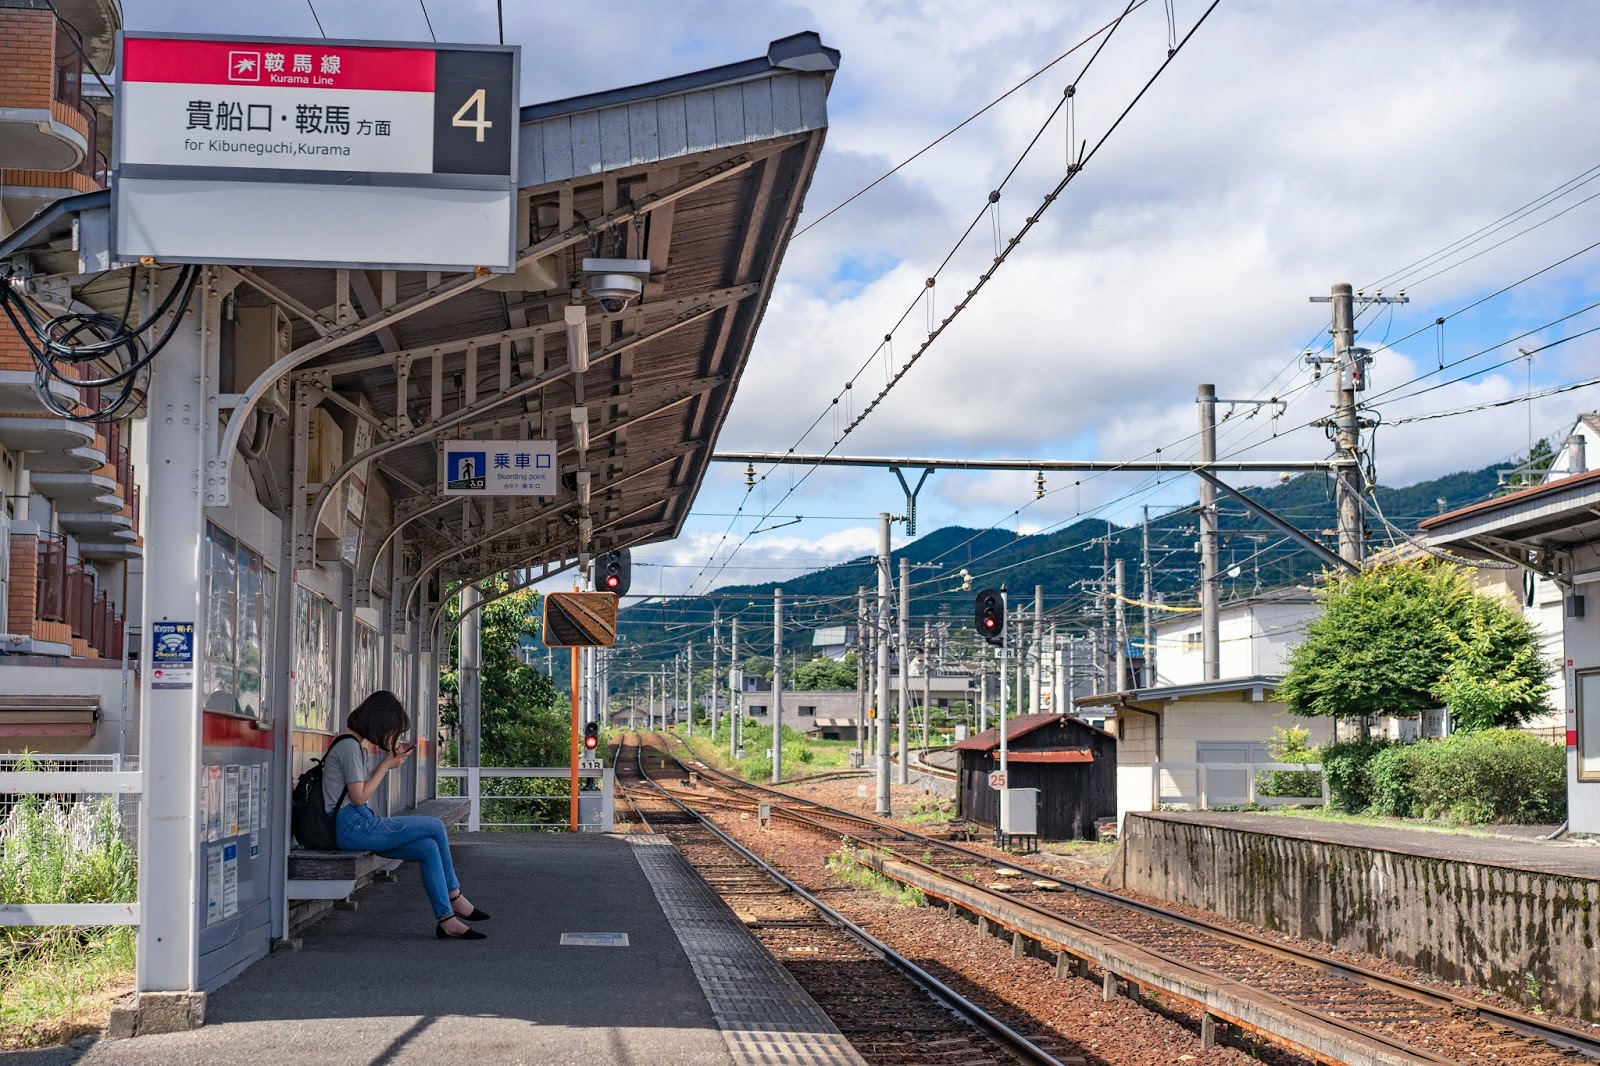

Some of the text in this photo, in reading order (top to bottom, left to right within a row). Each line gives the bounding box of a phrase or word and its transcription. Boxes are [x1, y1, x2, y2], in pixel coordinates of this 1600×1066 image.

[264, 52, 341, 75] 鞍馬線
[270, 74, 334, 85] Kurama Line
[451, 88, 493, 142] 4
[185, 138, 204, 151] for
[494, 453, 551, 469] 乗車口
[177, 624, 193, 633] Wi-Fi
[990, 774, 1005, 787] 25
